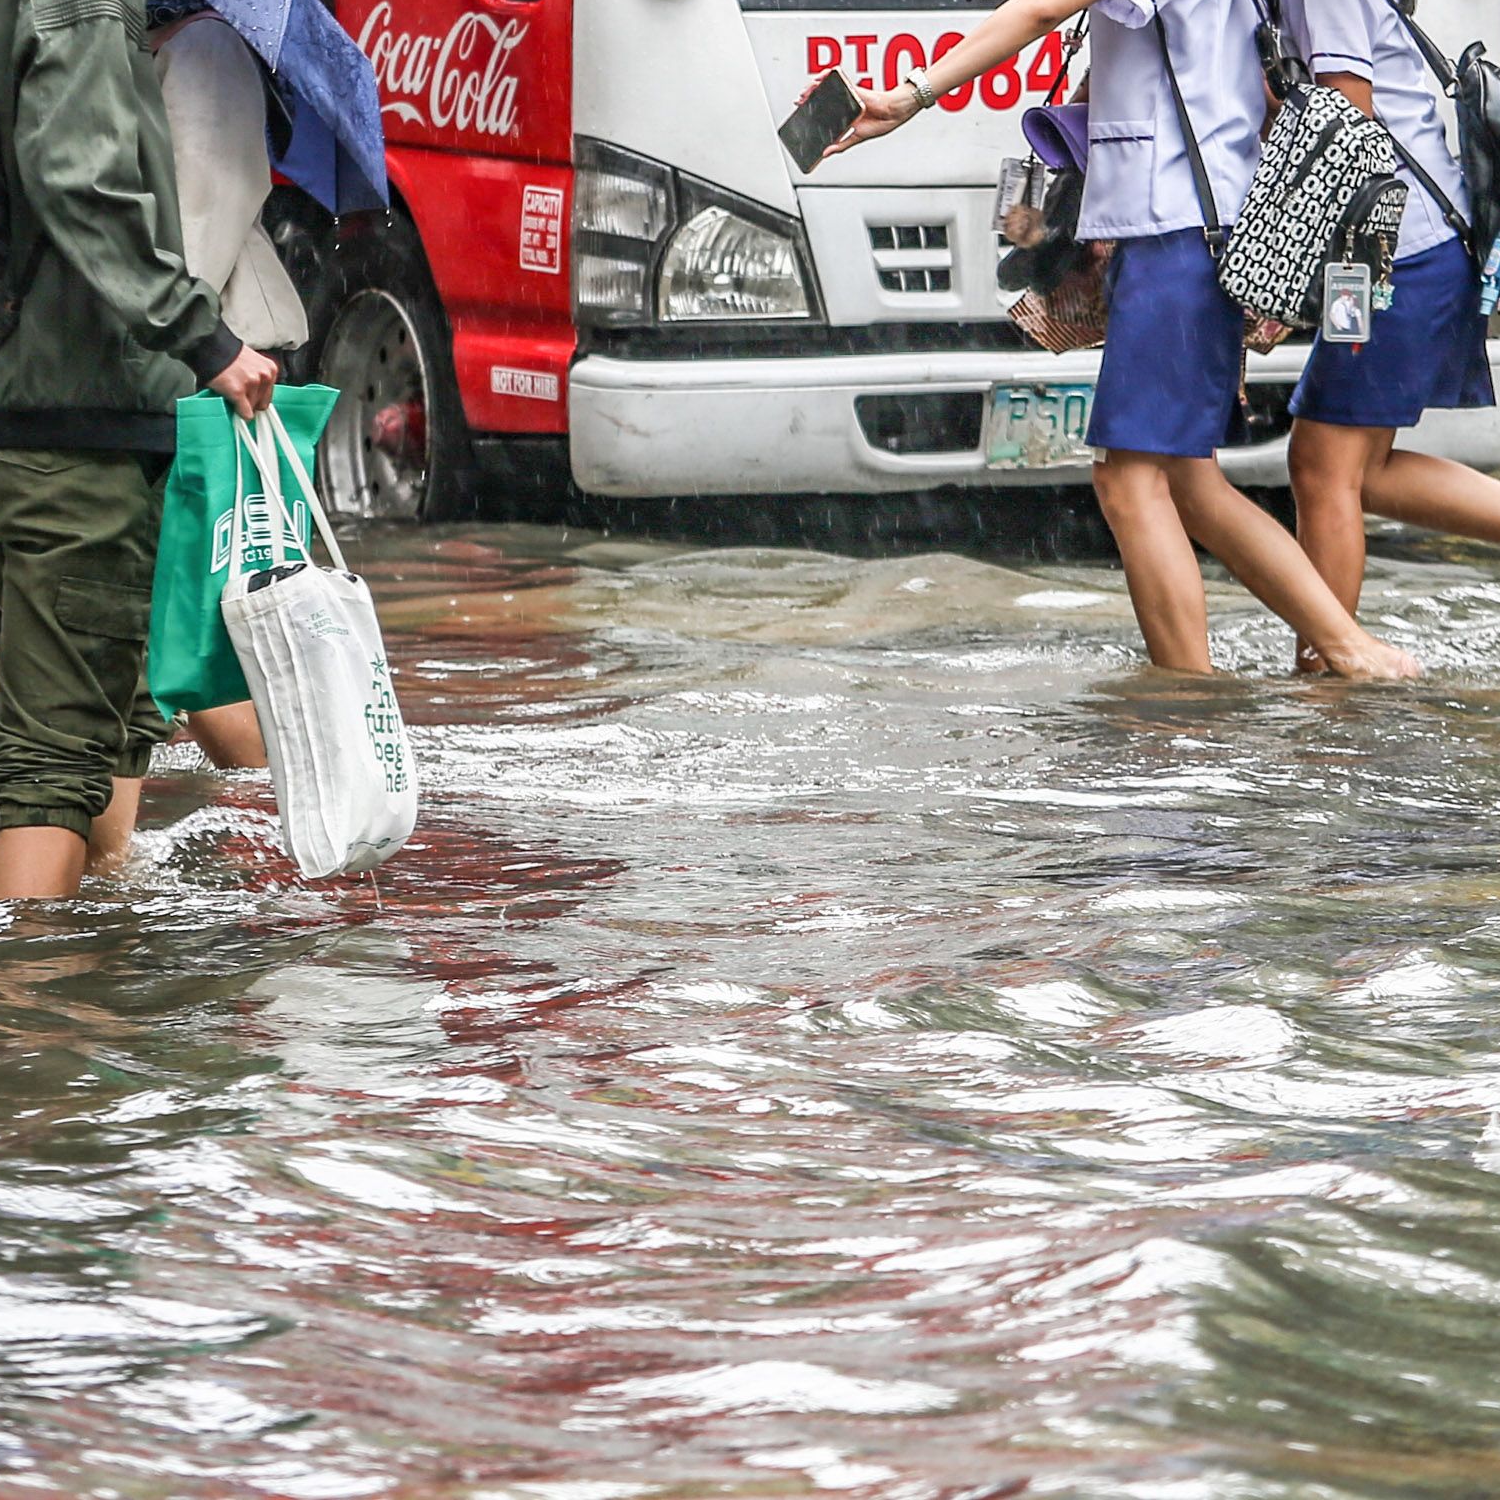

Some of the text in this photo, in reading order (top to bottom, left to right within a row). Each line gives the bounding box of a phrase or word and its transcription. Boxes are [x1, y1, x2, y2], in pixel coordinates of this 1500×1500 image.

[525, 191, 560, 217] CAPACITY
[493, 370, 557, 400] NOT FOR HIRE
